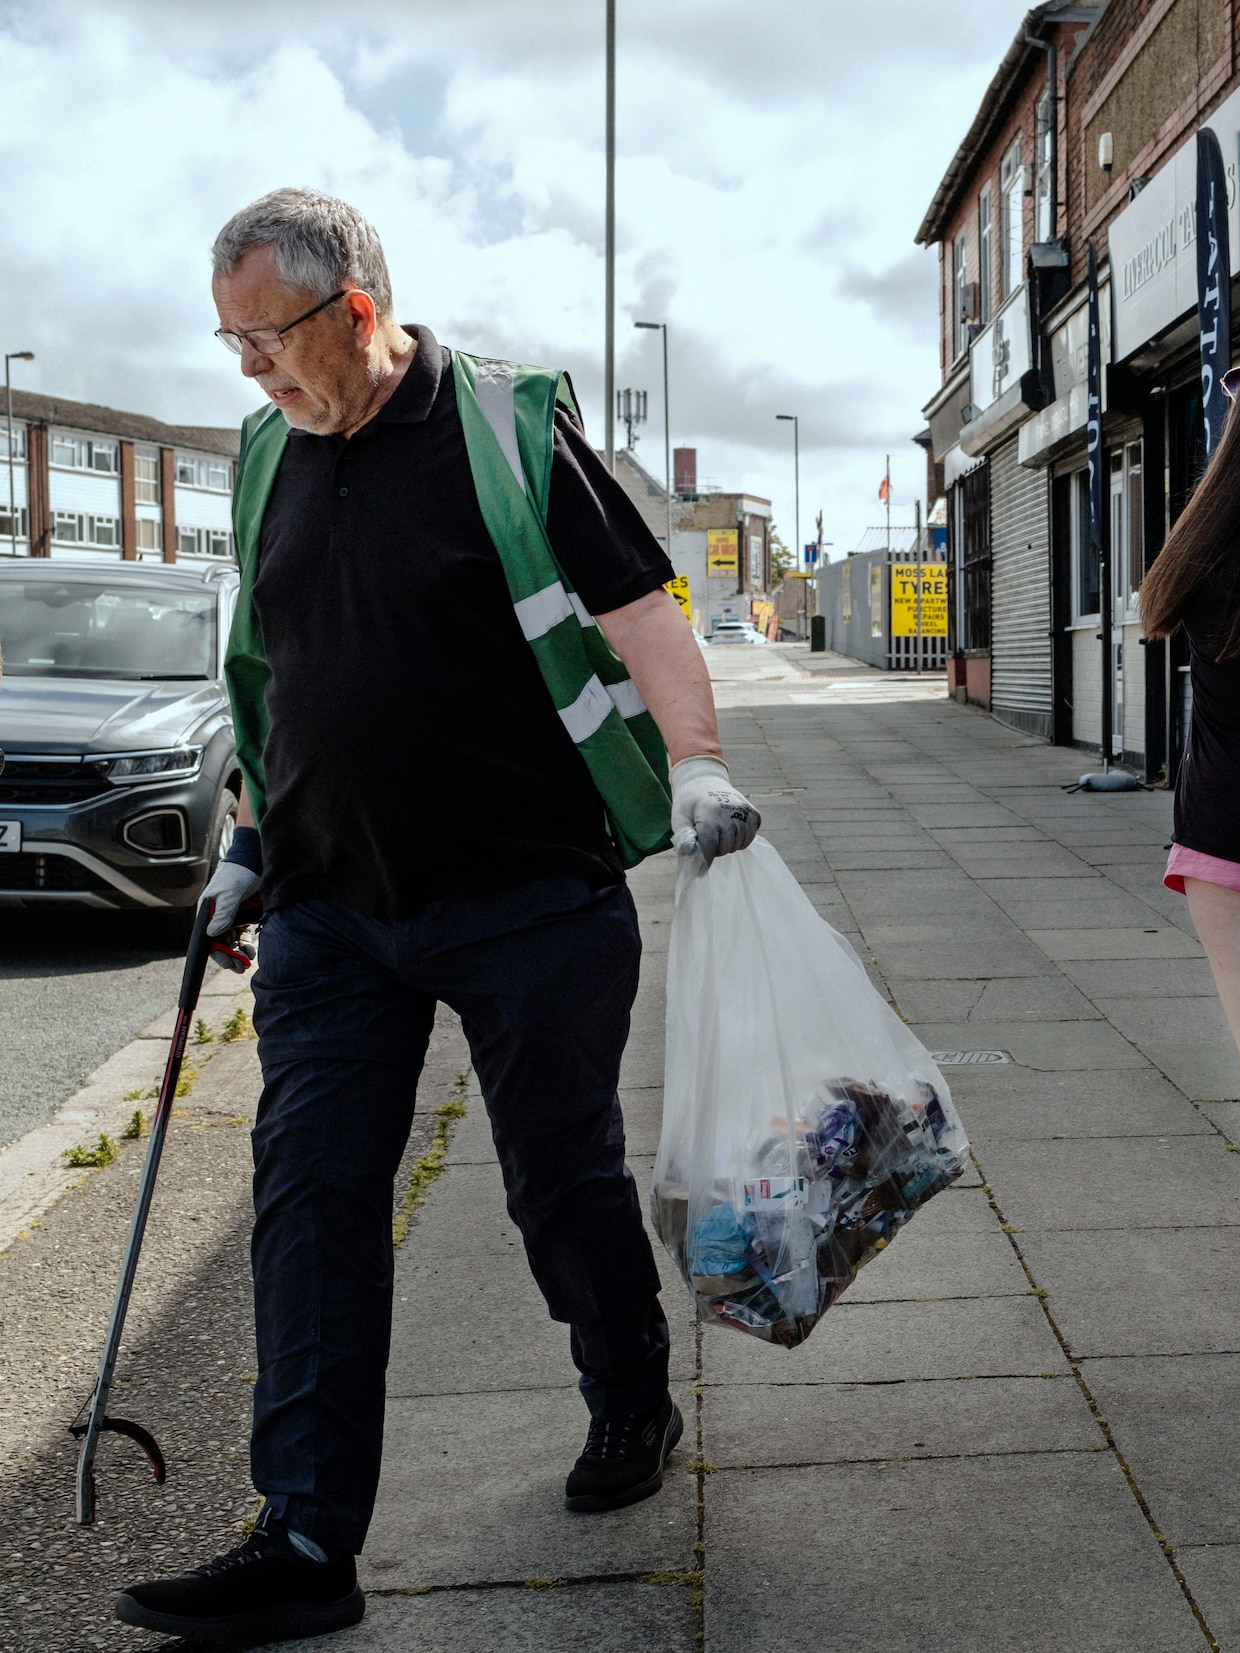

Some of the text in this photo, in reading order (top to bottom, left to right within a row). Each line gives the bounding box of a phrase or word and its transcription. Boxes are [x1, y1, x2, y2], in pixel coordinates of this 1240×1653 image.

[1122, 218, 1177, 303] LIVERPOOL
[895, 568, 948, 578] MOSS LA
[899, 581, 950, 595] TYRES
[894, 597, 912, 605] NEW
[920, 597, 948, 605] PARTW
